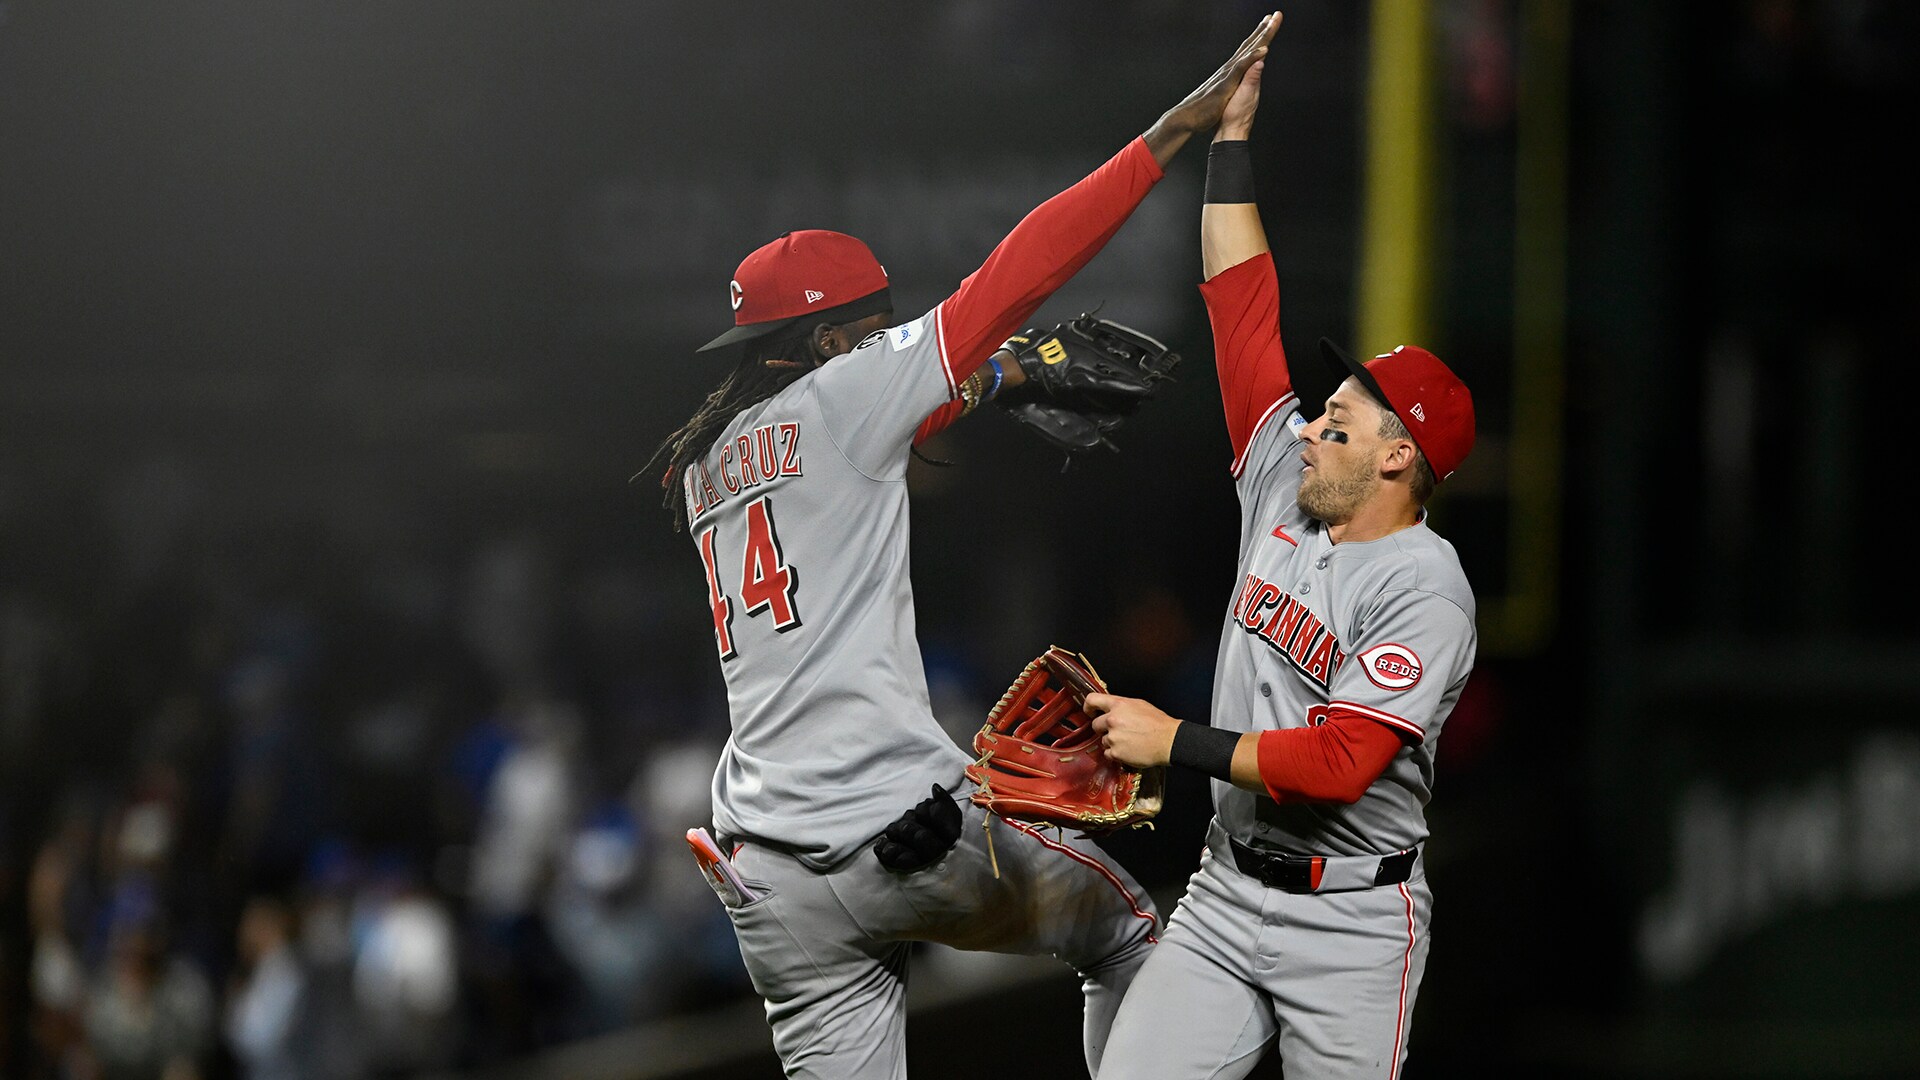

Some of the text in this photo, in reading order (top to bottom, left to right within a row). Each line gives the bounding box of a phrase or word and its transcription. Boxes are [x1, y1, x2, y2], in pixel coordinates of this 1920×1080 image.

[720, 422, 803, 494] CRUZ
[701, 496, 803, 663] 44
[1376, 658, 1420, 680] REDS
